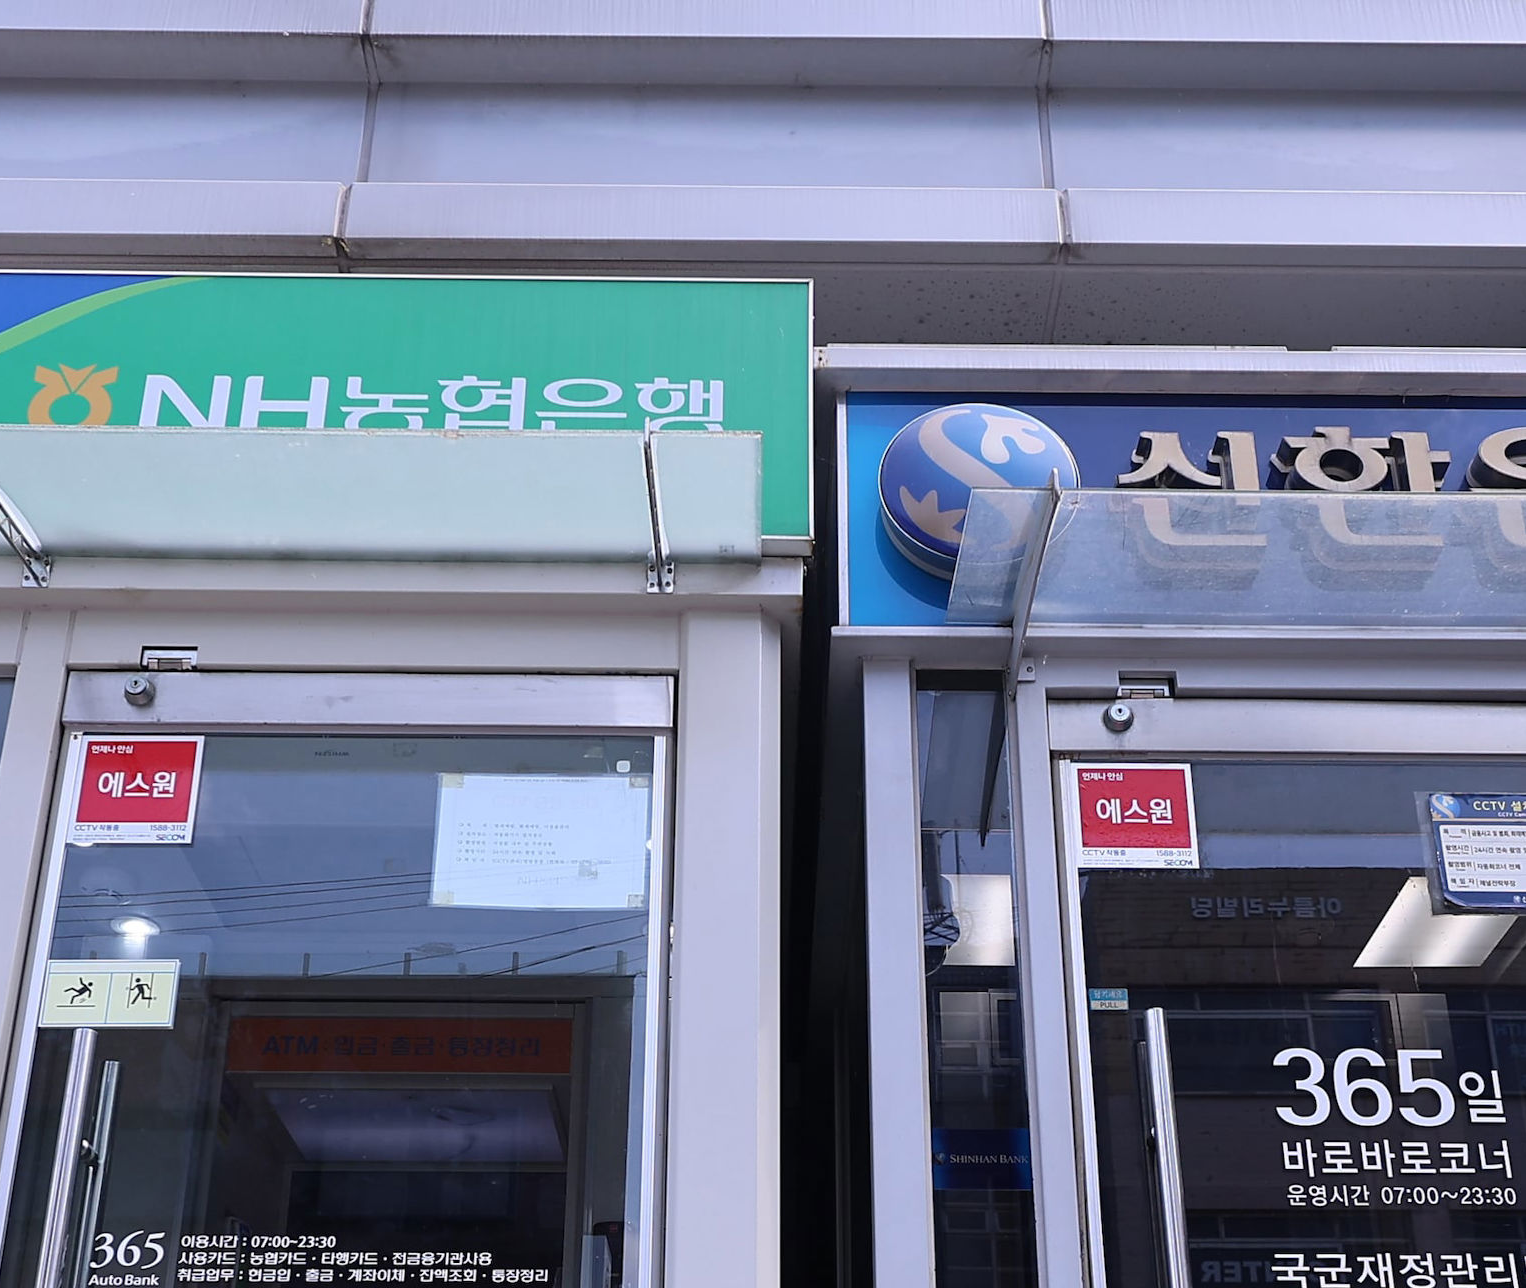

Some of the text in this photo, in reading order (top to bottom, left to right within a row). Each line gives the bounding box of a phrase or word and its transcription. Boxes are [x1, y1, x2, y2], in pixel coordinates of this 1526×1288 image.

[98, 771, 177, 798] 에스원
[1096, 798, 1173, 824] 에스원
[1473, 800, 1506, 811] CCTV
[1099, 1001, 1119, 1009] PULL
[262, 1035, 319, 1055] ATM
[1282, 1139, 1513, 1179] 바로바로코너
[1286, 1185, 1517, 1206] 운영시간 07:00~23:30
[89, 1230, 166, 1270] 365
[180, 1235, 238, 1249] 이용시간
[250, 1235, 336, 1249] 07:00~23:30
[177, 1252, 236, 1265] 사용카드
[250, 1252, 307, 1265] 농협카드
[321, 1252, 378, 1265] 타행카드
[392, 1252, 492, 1266] 전금융기관사용
[88, 1274, 160, 1286] Auto Bank
[177, 1268, 235, 1282] 취급업무
[305, 1268, 334, 1282] 출금
[348, 1268, 406, 1283] 계좌이체
[419, 1268, 477, 1283] 잔액조회
[491, 1268, 549, 1283] 통장정리
